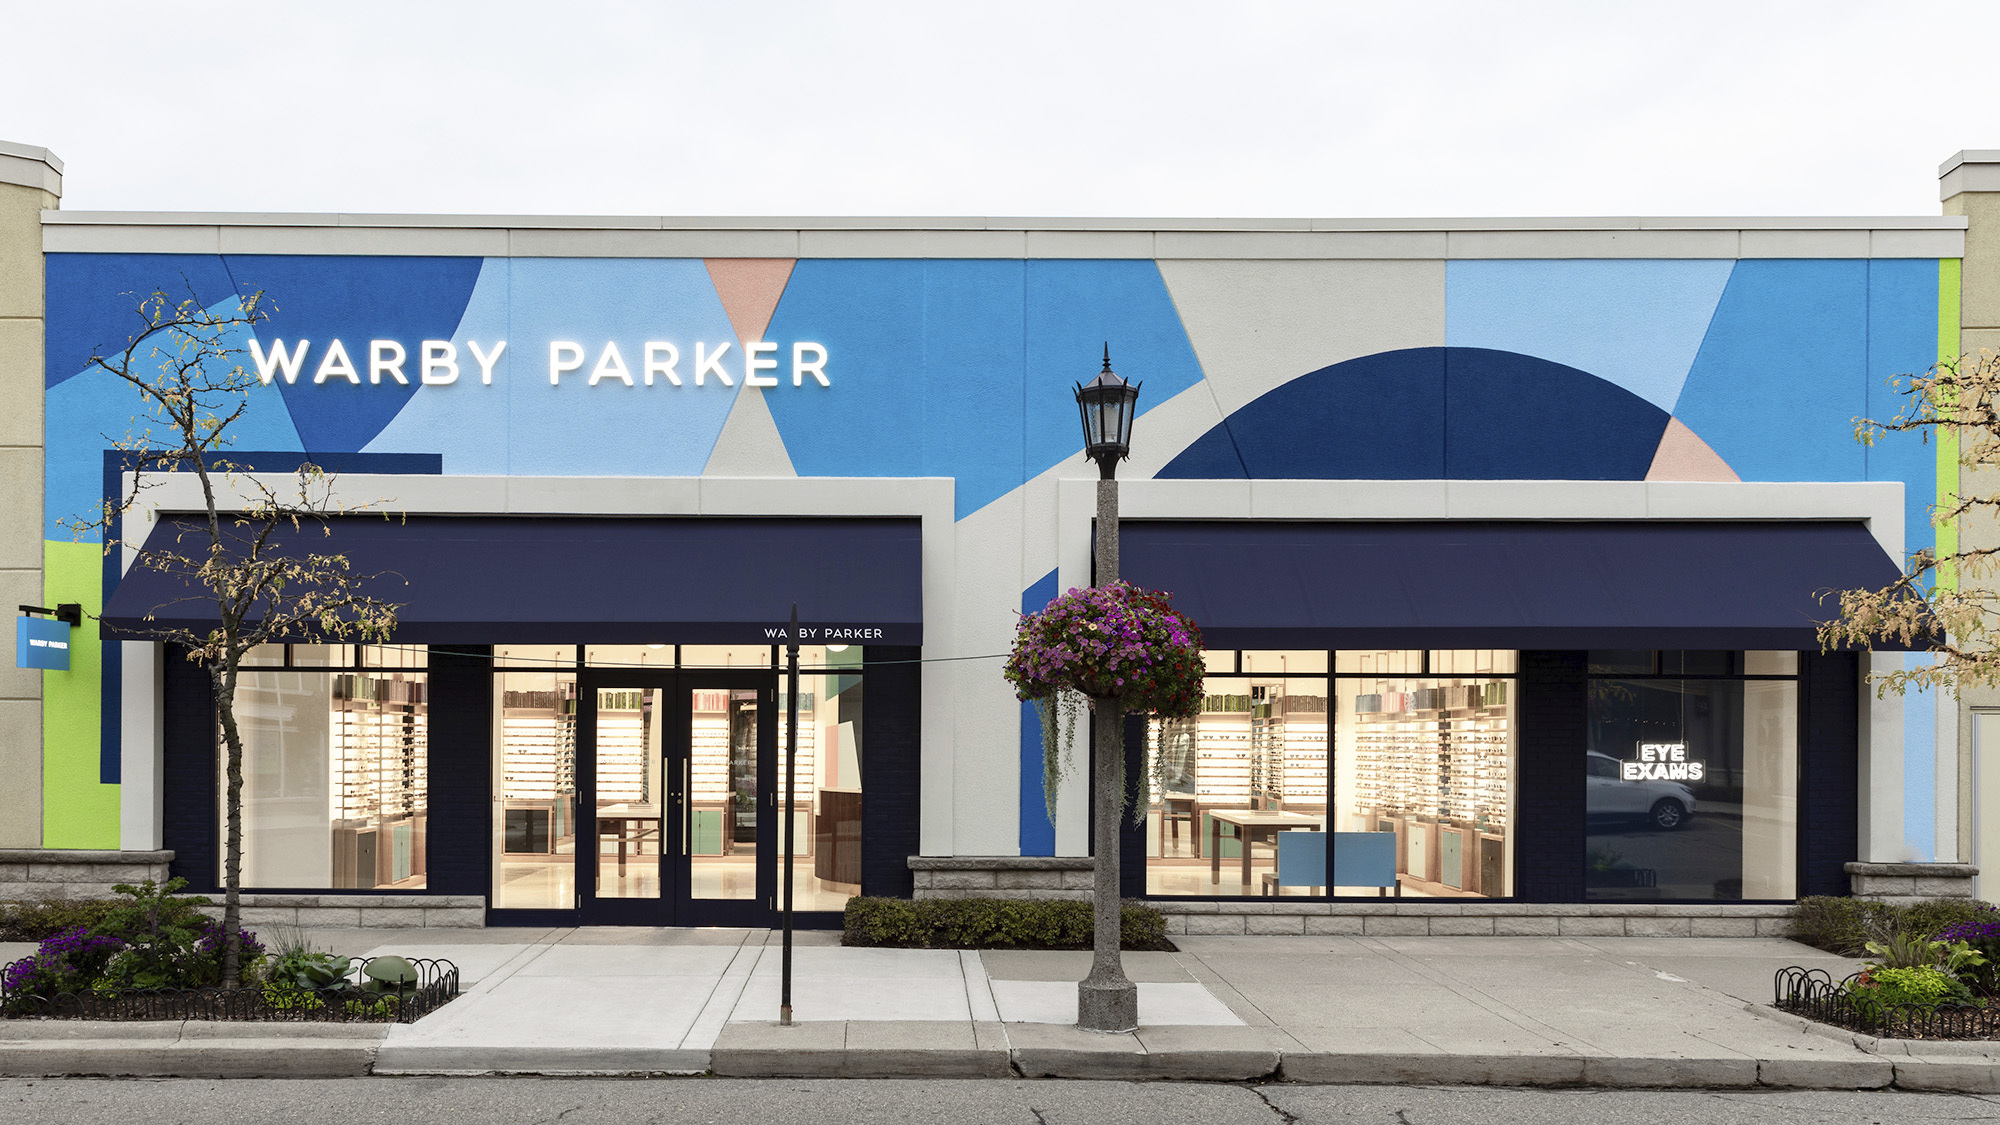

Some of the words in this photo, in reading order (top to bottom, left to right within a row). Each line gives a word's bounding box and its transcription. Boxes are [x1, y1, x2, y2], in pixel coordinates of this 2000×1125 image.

[248, 337, 507, 386] WARBY
[549, 340, 831, 388] PARKER
[764, 628, 818, 639] WABY
[824, 628, 883, 639] PARKER
[1641, 744, 1685, 762] EYE
[1623, 762, 1703, 781] EXAMS
